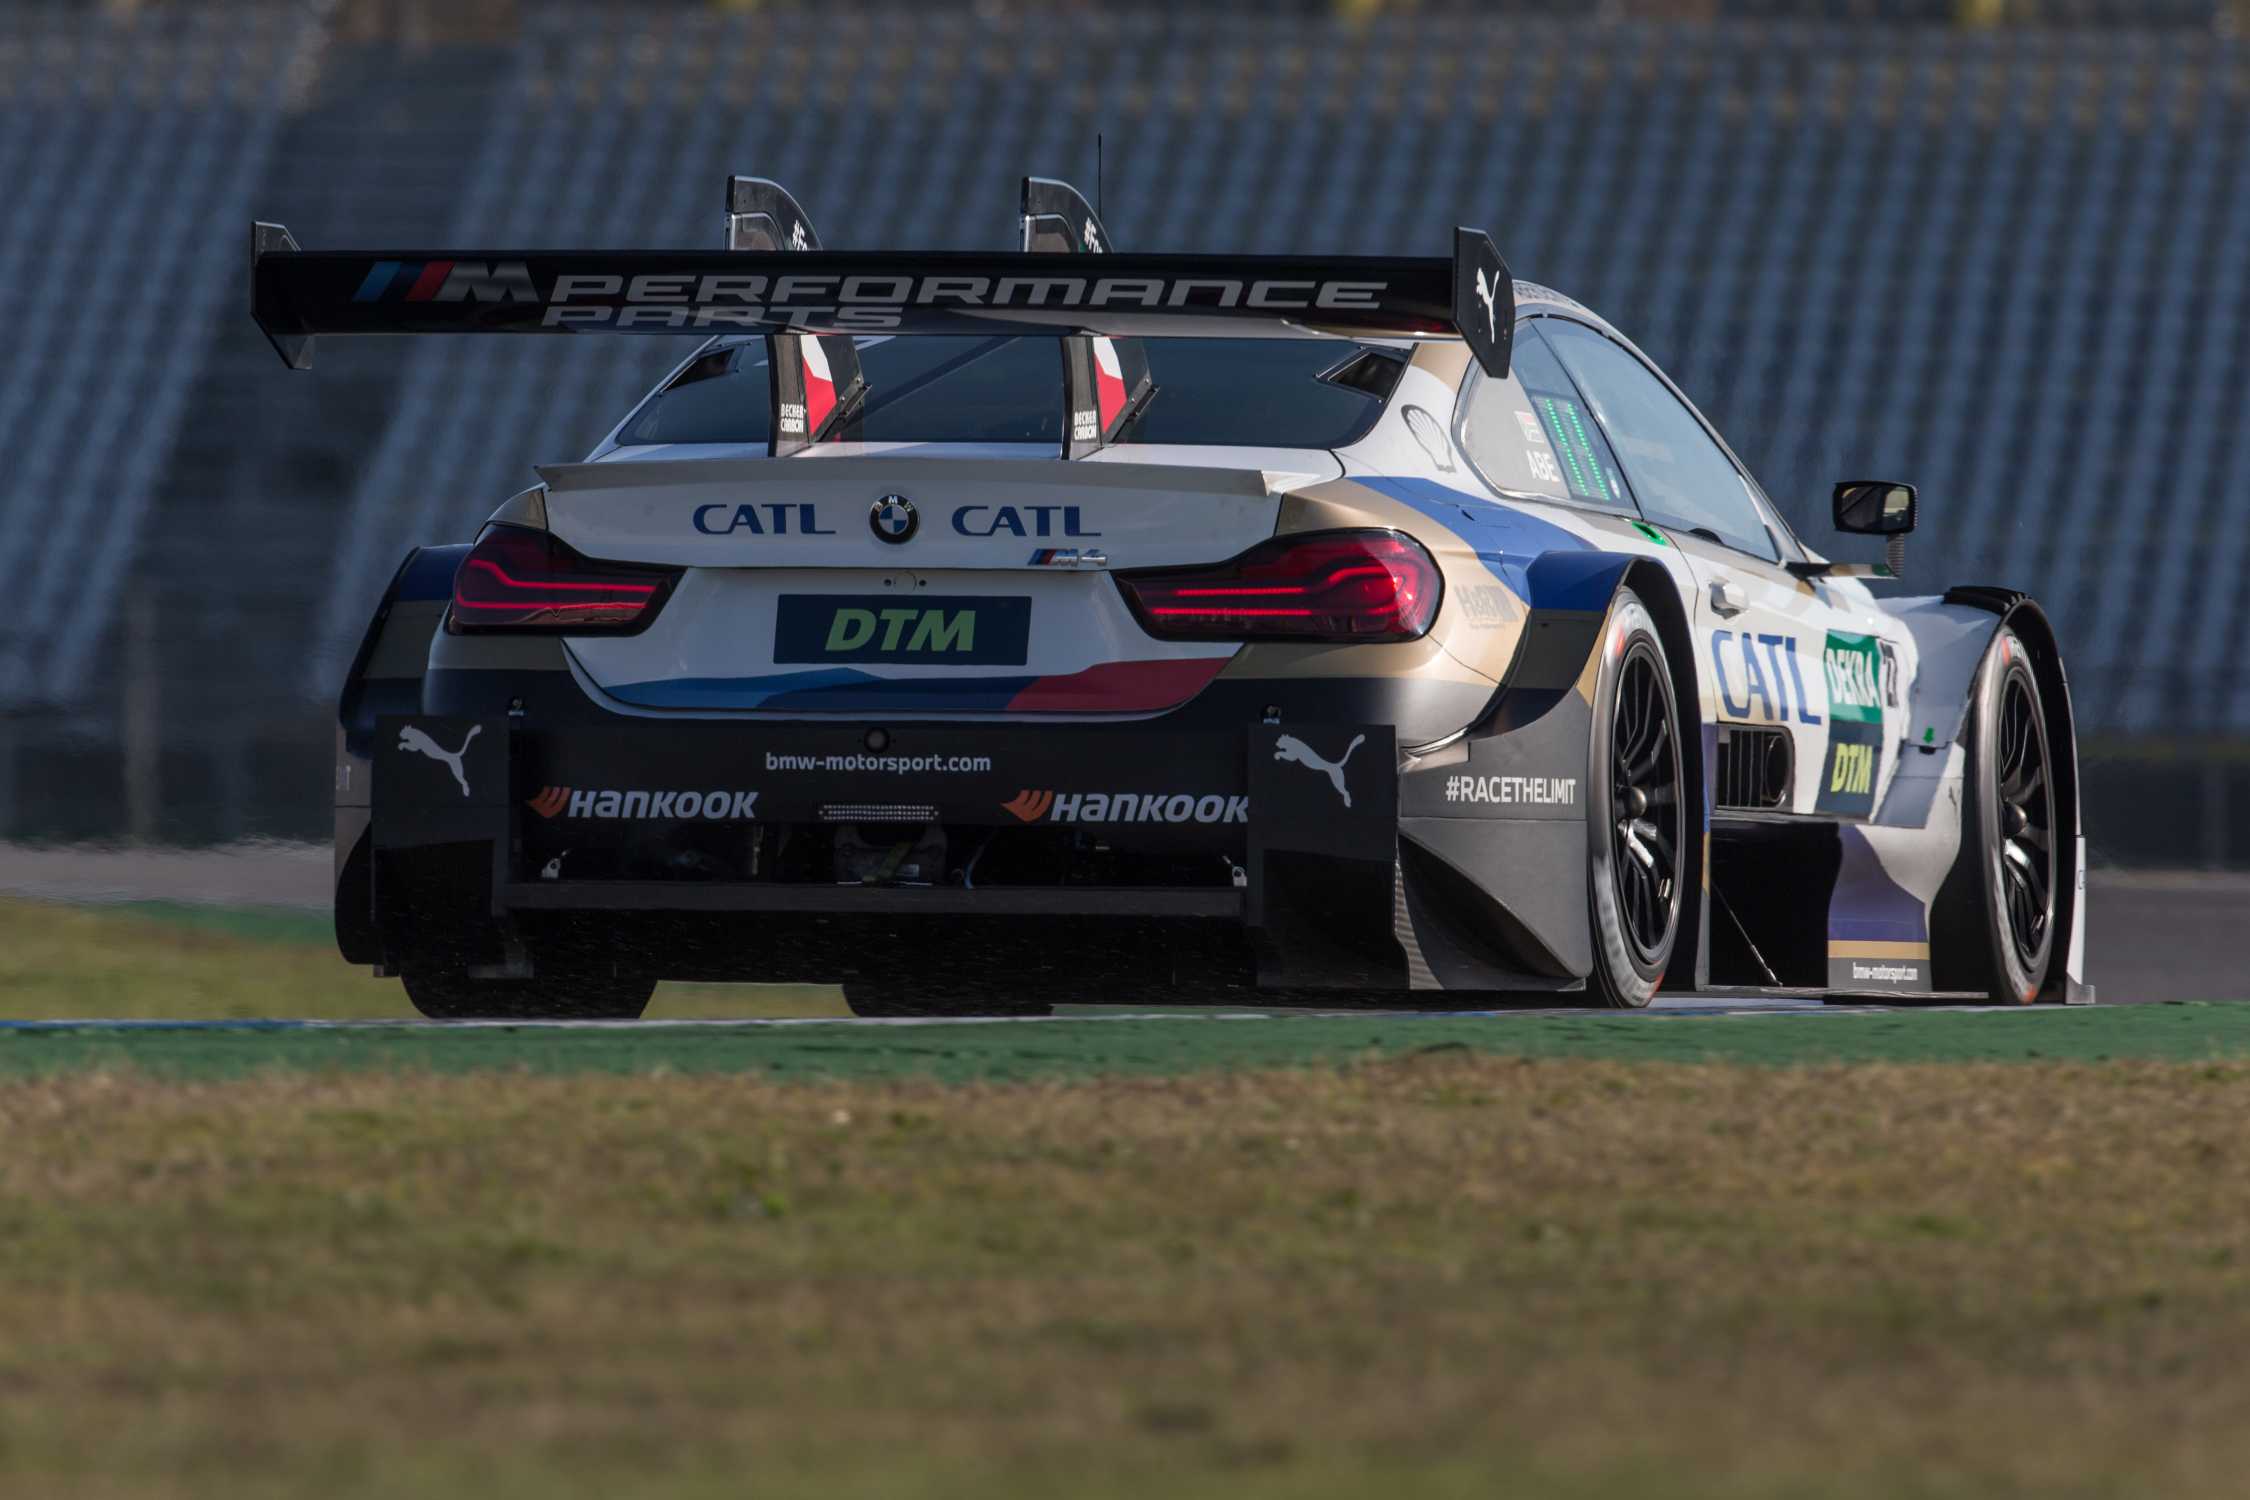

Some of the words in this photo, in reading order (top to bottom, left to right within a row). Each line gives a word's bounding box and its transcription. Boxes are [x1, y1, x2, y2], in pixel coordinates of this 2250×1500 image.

[549, 275, 1387, 309] PERFORMANCE
[542, 305, 905, 328] PARTS
[693, 504, 836, 535] CATL
[952, 506, 1102, 537] CATL
[825, 608, 977, 652] DTM
[1711, 629, 1822, 725] CATL
[1825, 648, 1882, 708] DEKRA
[765, 751, 991, 776] bmw-motorsport.com
[1830, 743, 1873, 794] DTM
[1446, 776, 1576, 805] #RACETHELIMIT
